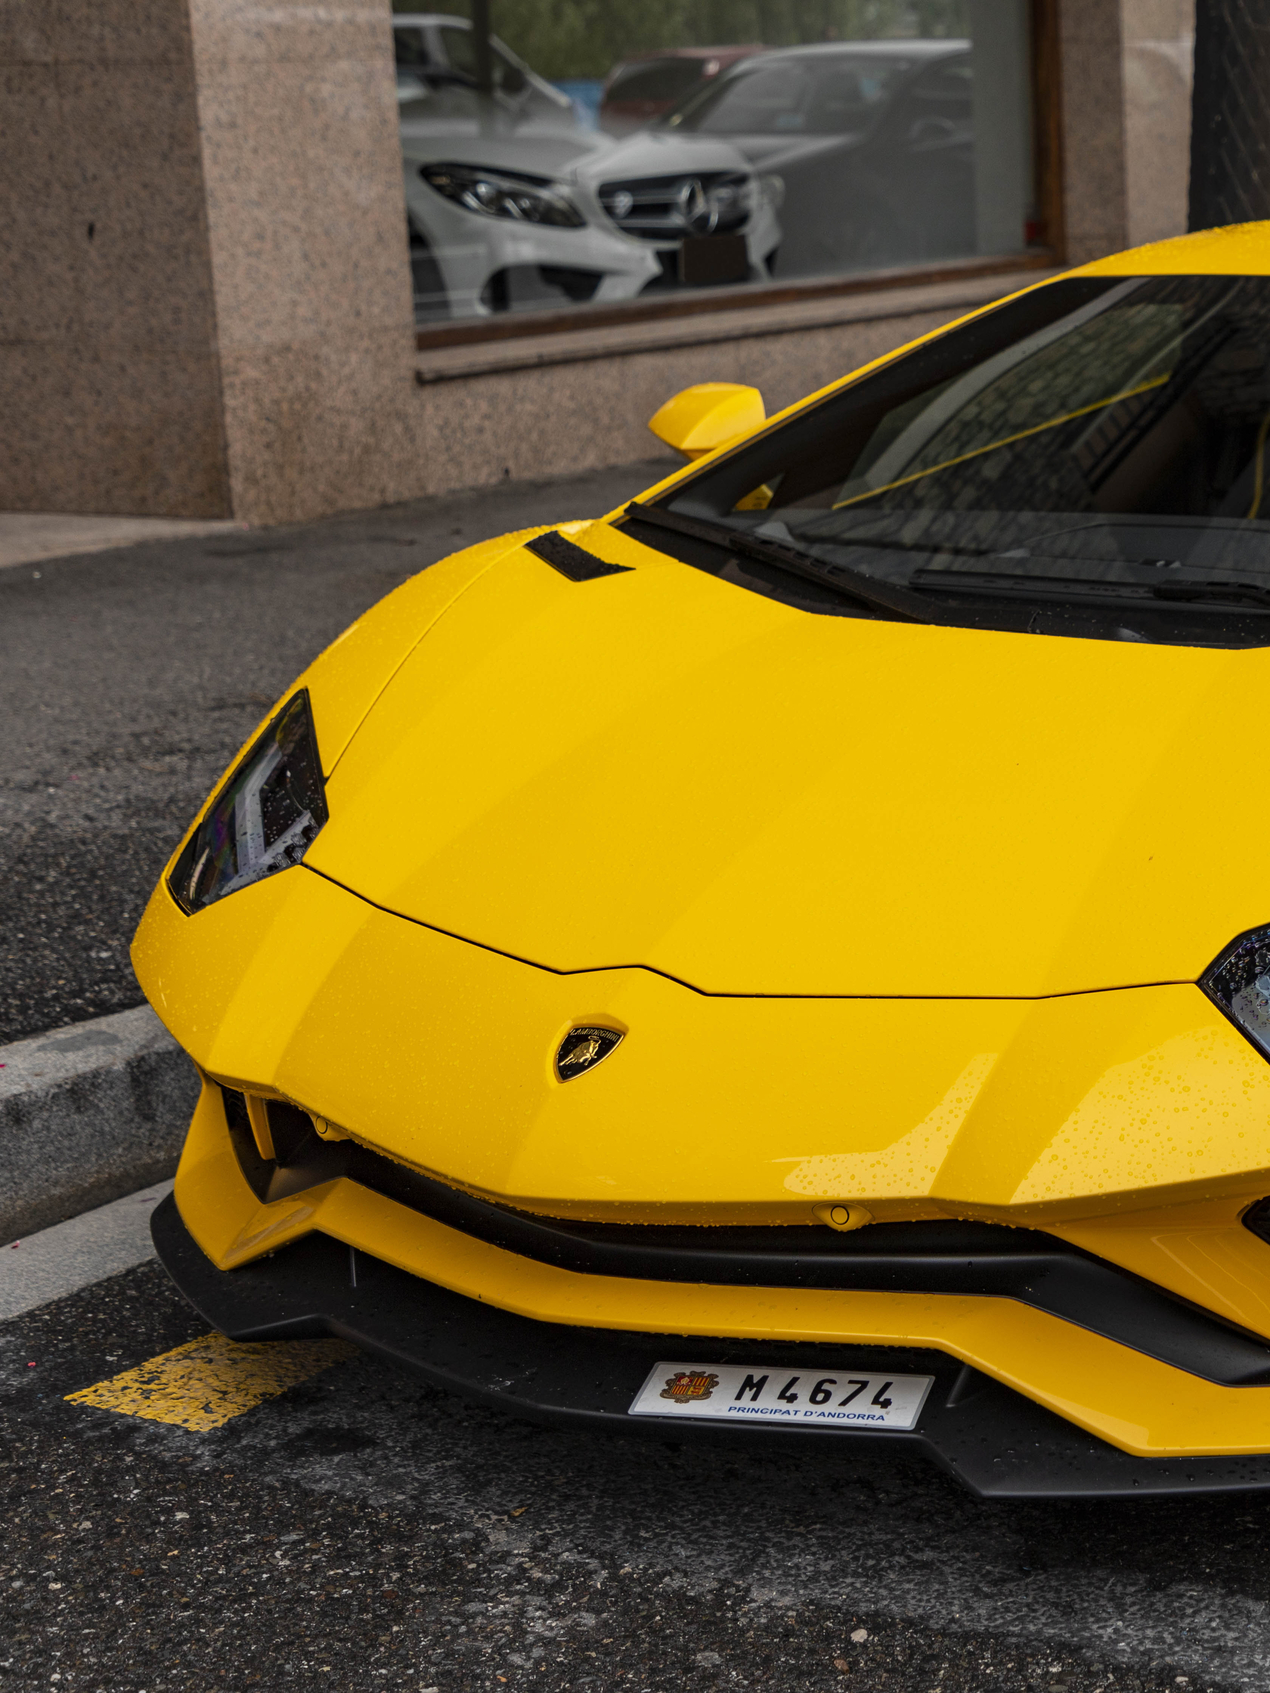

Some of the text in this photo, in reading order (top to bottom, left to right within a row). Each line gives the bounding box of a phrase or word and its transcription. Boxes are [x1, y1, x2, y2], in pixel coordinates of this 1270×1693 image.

[570, 1028, 620, 1042] LAMBORGHINI
[733, 1373, 894, 1410] M 4674
[727, 1405, 886, 1422] PRINCIPAT D'ANDORRA
